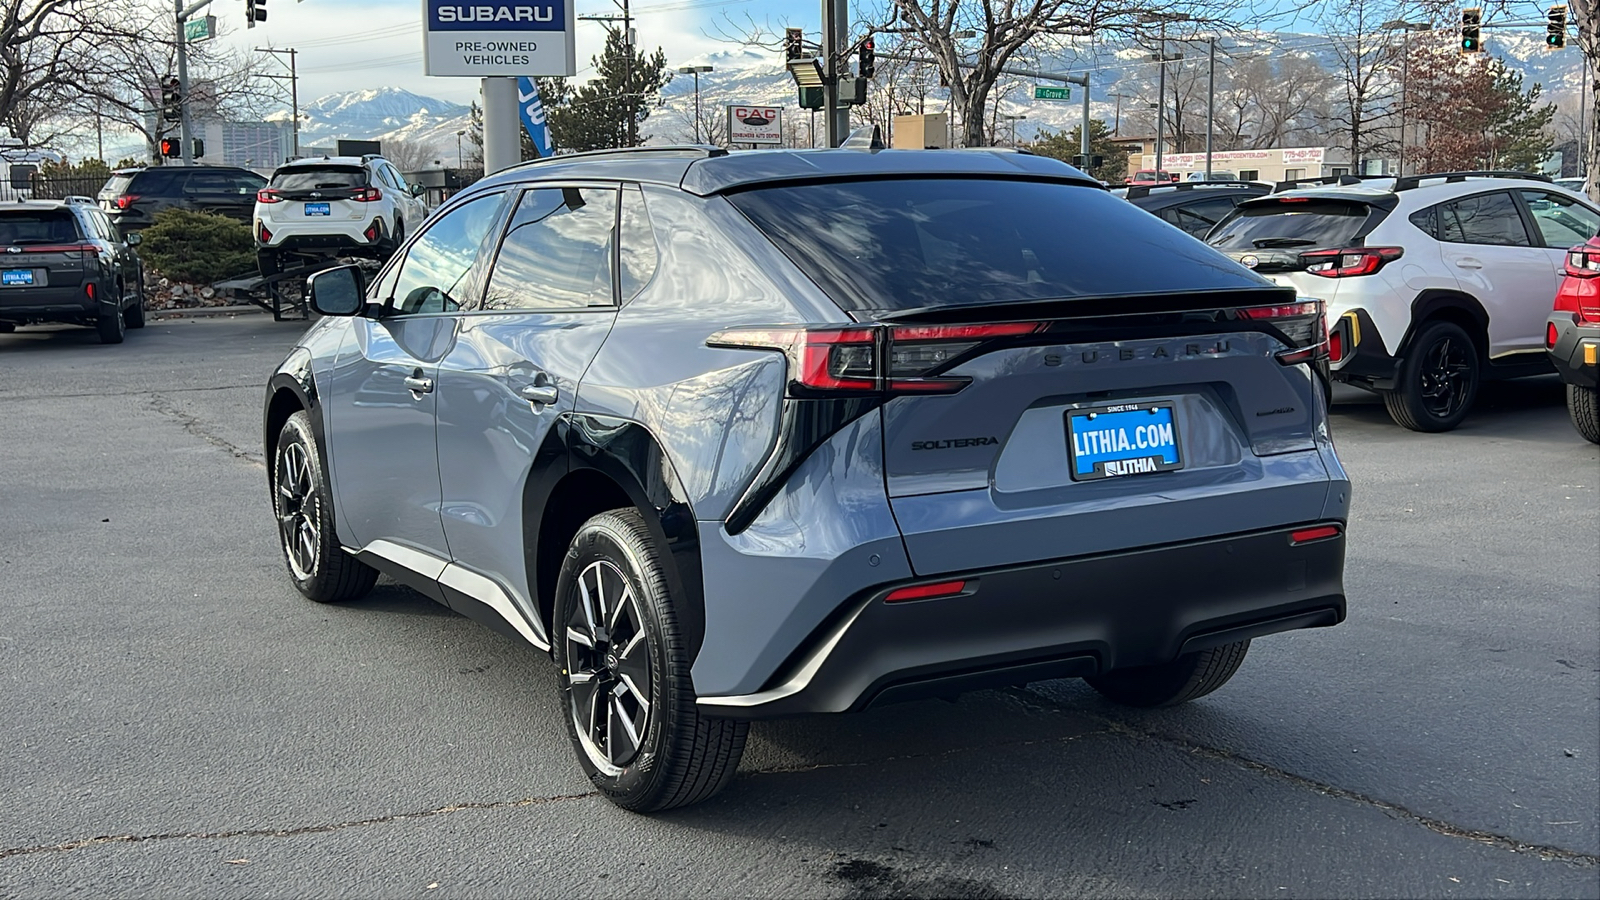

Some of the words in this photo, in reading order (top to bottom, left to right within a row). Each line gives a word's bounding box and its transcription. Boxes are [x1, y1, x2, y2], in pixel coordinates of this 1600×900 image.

[437, 6, 553, 22] SUBARU
[455, 42, 537, 52] PRE-OWNED
[463, 55, 530, 65] VEHICLES
[1046, 89, 1062, 98] Grove
[736, 108, 776, 118] CAC
[1284, 150, 1322, 158] 775-451-7021
[1043, 340, 1231, 367] SUBARU
[1107, 405, 1125, 413] SINCE
[911, 436, 999, 451] SOLTERRA
[1073, 422, 1175, 457] LITHIA.COM
[1116, 457, 1157, 476] LITHIA
